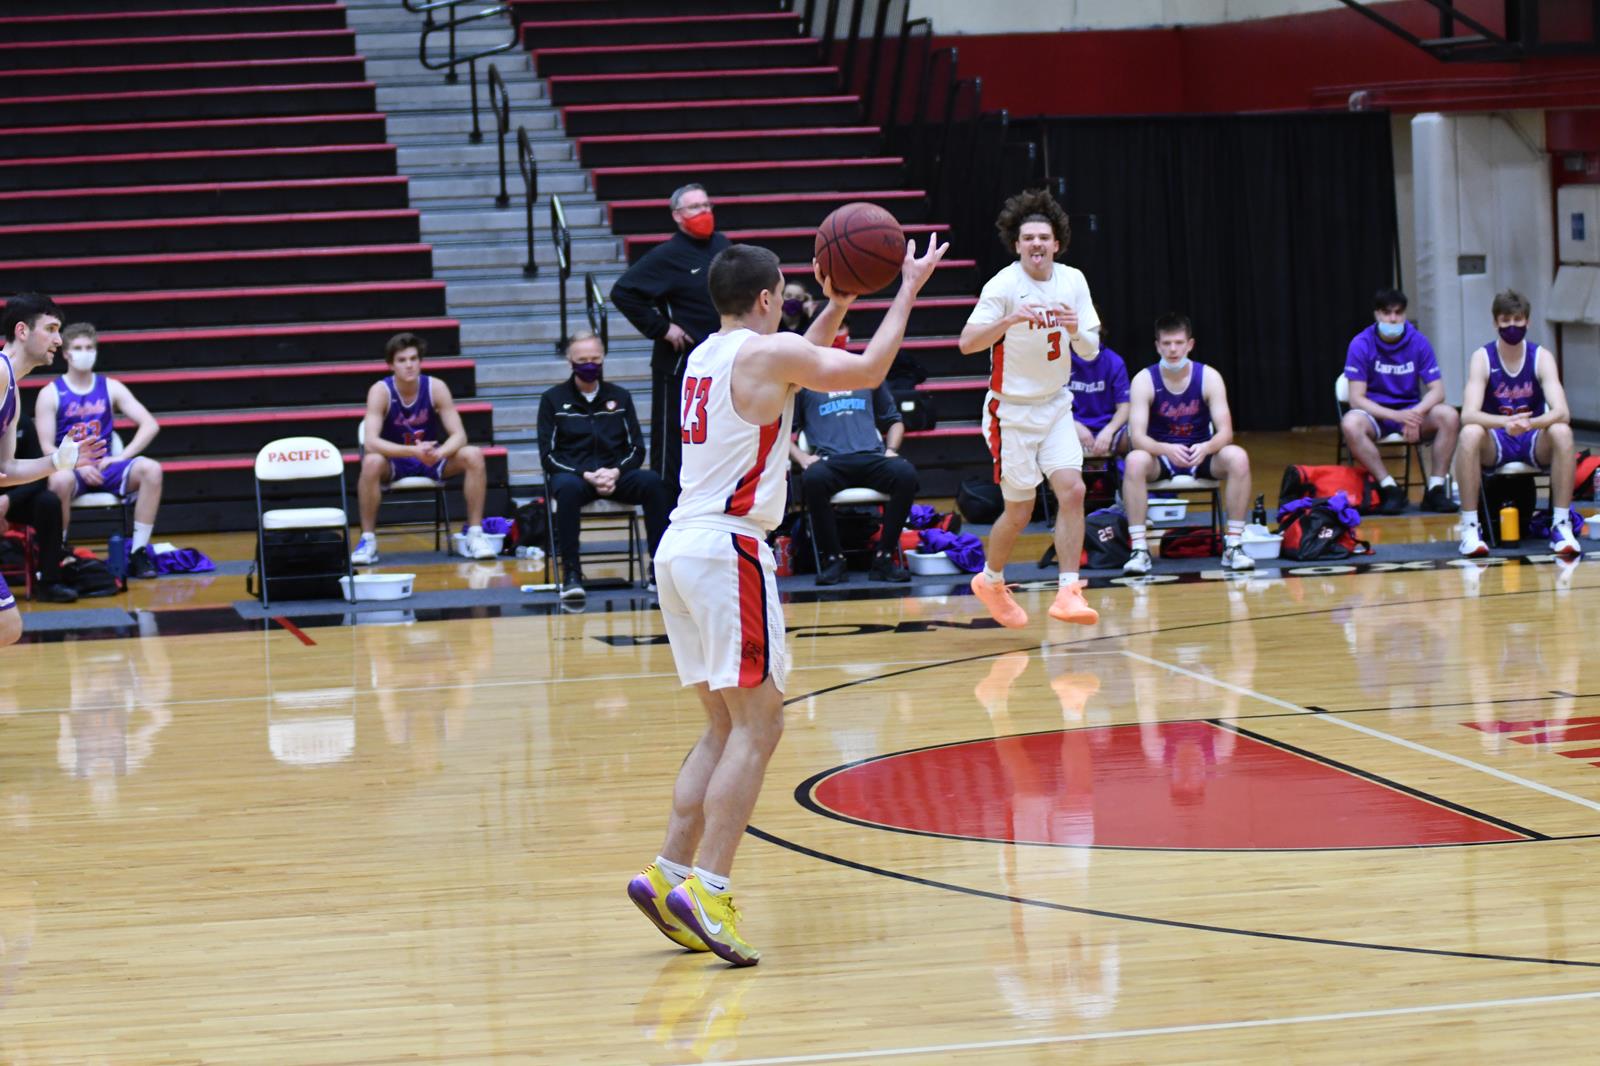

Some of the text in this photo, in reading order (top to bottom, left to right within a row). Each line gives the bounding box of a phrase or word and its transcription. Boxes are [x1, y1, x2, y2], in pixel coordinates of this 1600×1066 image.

[1047, 331, 1062, 361] 3
[681, 376, 713, 444] 23
[268, 448, 331, 462] PACIFIC
[1098, 526, 1114, 542] 25
